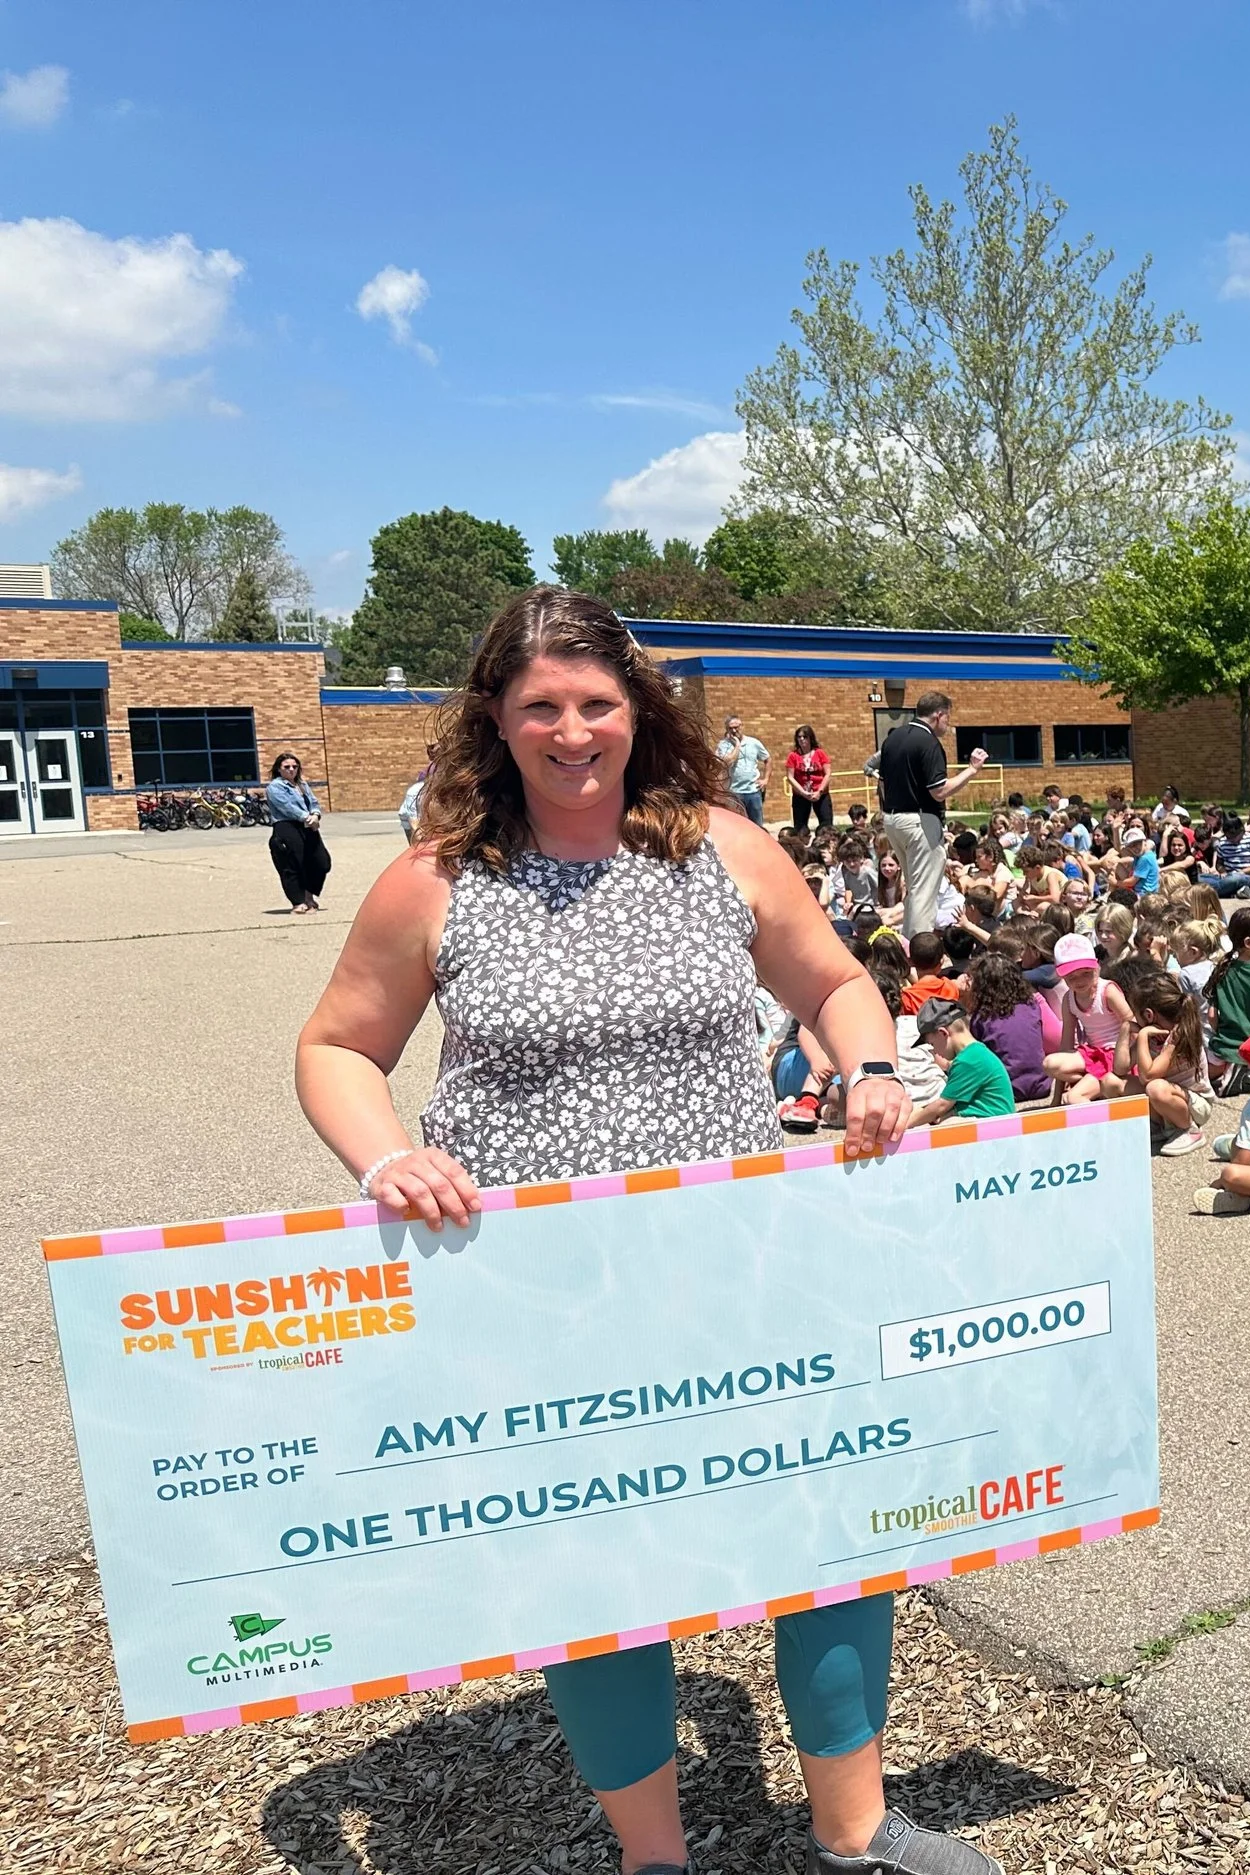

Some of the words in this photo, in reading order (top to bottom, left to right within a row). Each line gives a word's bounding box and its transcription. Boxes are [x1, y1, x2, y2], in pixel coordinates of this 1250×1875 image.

[869, 694, 882, 702] 10
[80, 731, 95, 739] 13
[955, 1172, 1021, 1203] MAY
[1030, 1160, 1098, 1190] 2025
[123, 1333, 177, 1355] FOR
[182, 1301, 417, 1360] TEACHERS
[909, 1300, 1085, 1362] $1,000.00
[258, 1352, 305, 1370] tropical
[304, 1347, 343, 1368] CAFE
[375, 1411, 488, 1458] AMY
[504, 1353, 836, 1438] FITZSIMMONS
[153, 1453, 208, 1477] PAY
[215, 1447, 255, 1467] TO
[261, 1437, 319, 1460] THE
[156, 1472, 259, 1501] ORDER
[267, 1464, 305, 1485] OF
[279, 1513, 394, 1558] ONE
[404, 1465, 687, 1537] THOUSAND
[702, 1417, 912, 1486] DOLLARS
[870, 1486, 977, 1534] tropical
[980, 1464, 1065, 1520] CAFE
[924, 1513, 978, 1535] SMOOTHIE
[240, 1616, 261, 1634] C
[186, 1633, 333, 1675] CAMPUS
[206, 1658, 321, 1686] MULTIMEDIA
